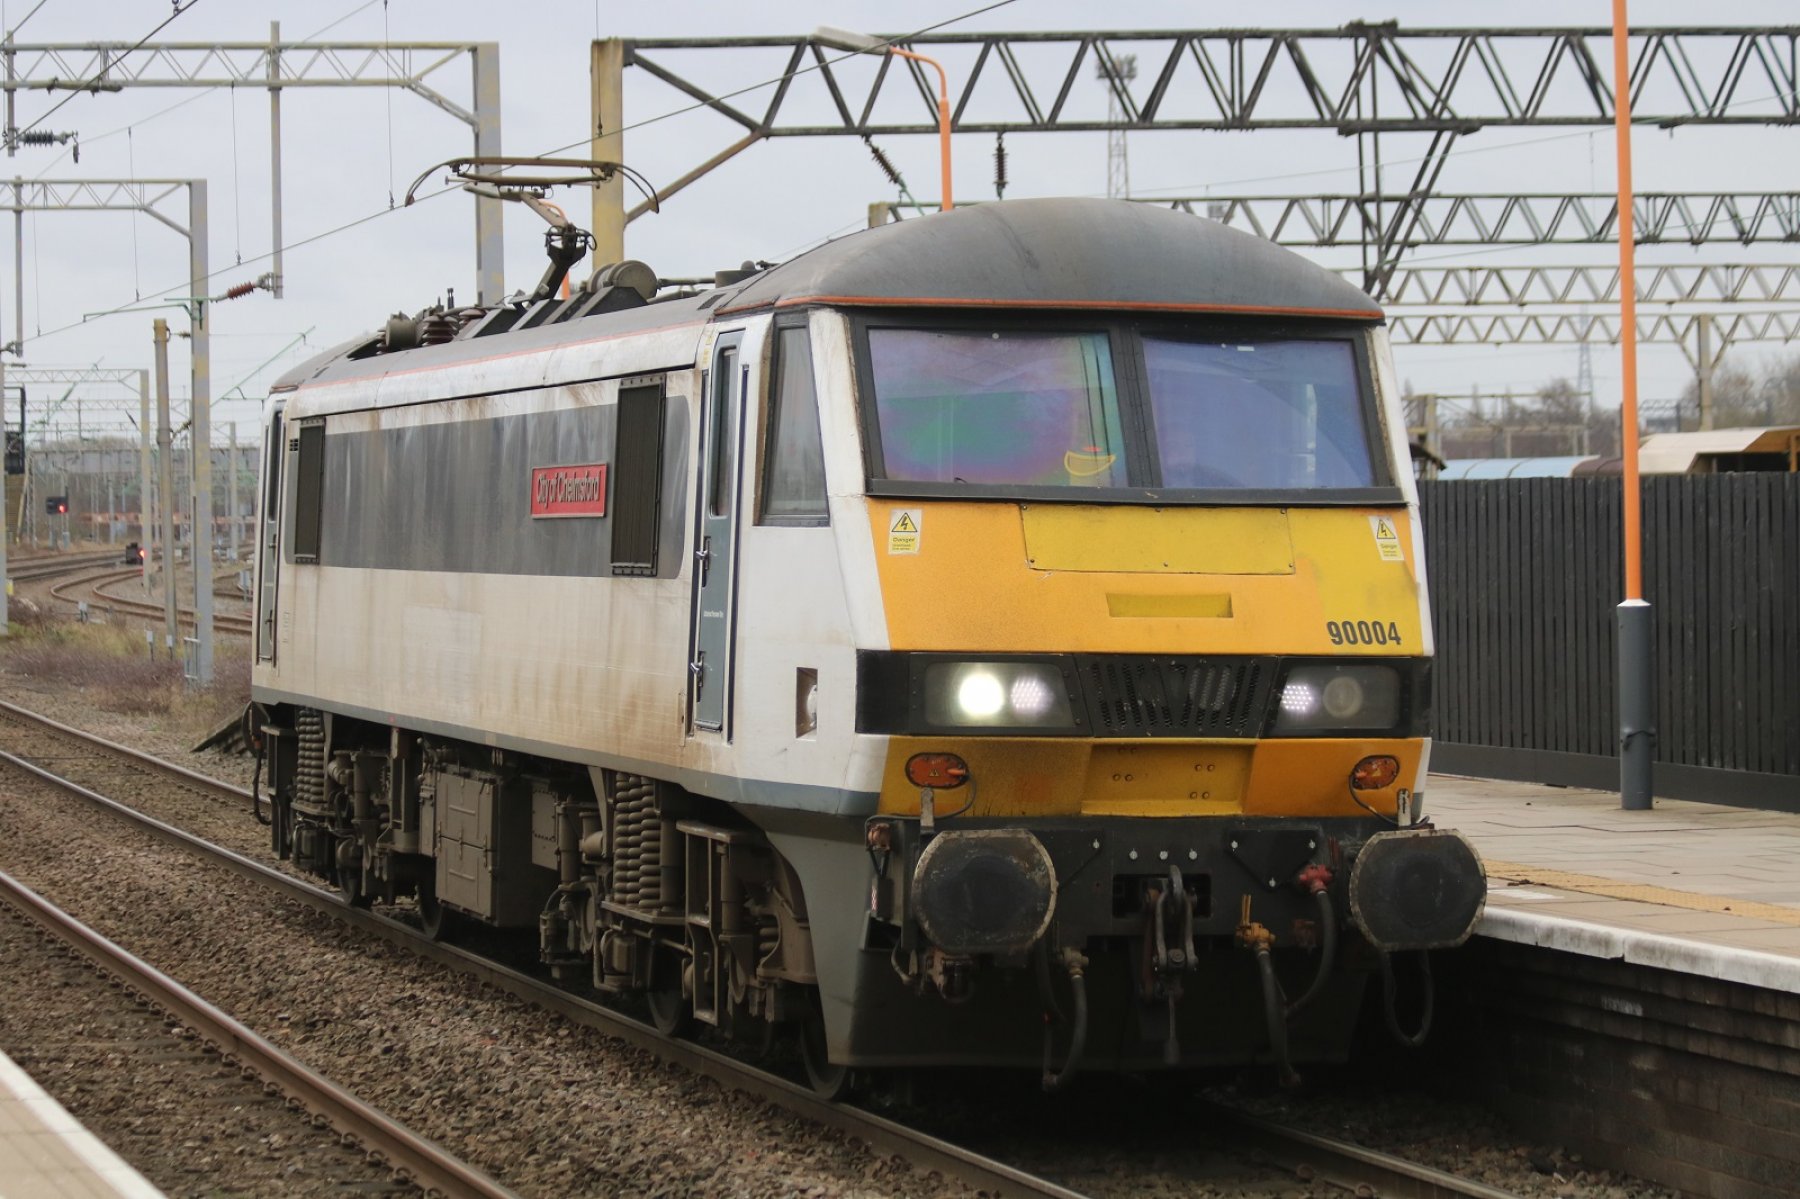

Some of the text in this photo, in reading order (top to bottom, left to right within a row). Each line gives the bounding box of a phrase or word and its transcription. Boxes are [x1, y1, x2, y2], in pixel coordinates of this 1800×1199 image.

[537, 470, 601, 509] City of Chelmsford
[1327, 620, 1401, 646] 90004
